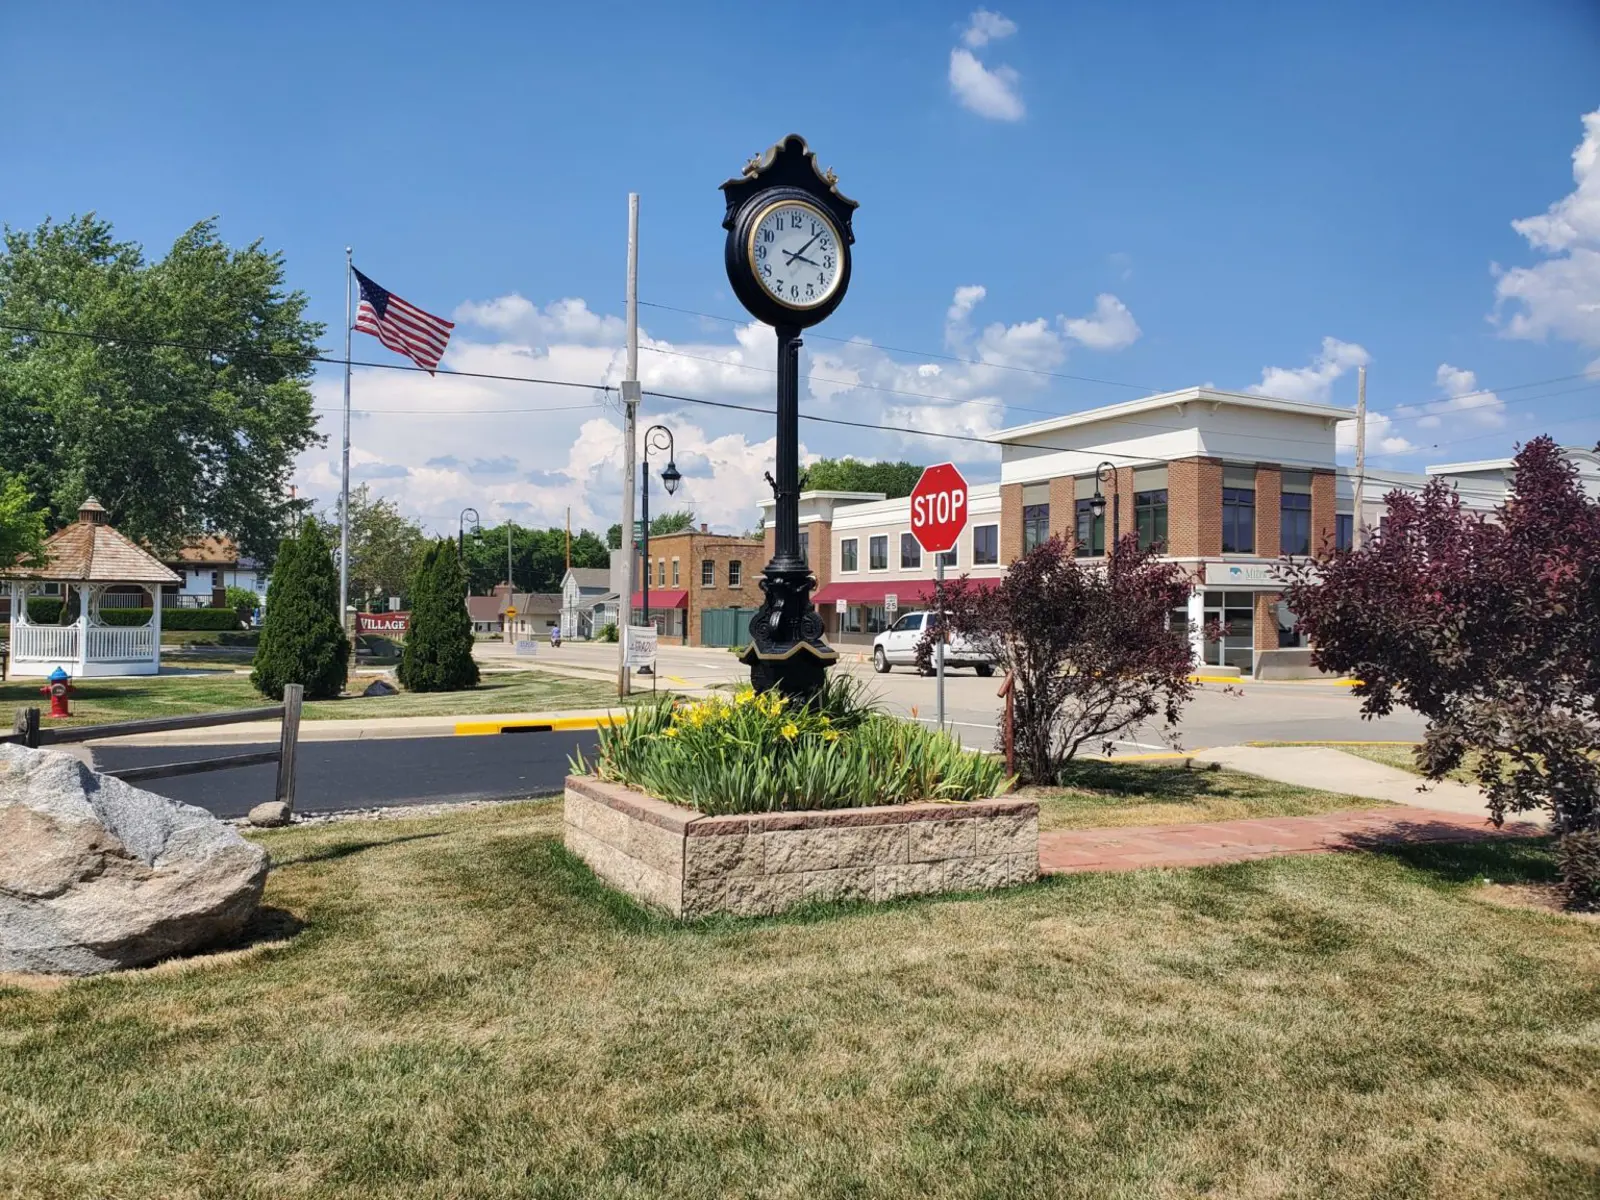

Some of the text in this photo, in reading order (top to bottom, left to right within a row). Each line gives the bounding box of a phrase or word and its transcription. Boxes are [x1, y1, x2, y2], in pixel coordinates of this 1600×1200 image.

[776, 217, 784, 231] 11
[791, 215, 803, 229] 12
[763, 229, 775, 243] 10
[811, 223, 815, 236] 1
[820, 238, 828, 251] 2
[759, 245, 767, 259] 9
[823, 255, 832, 269] 3
[763, 264, 772, 277] 8
[817, 272, 825, 285] 4
[776, 279, 784, 292] 7
[791, 285, 799, 298] 6
[805, 283, 814, 296] 5
[913, 489, 964, 527] STOP
[360, 618, 406, 630] VILLAGE
